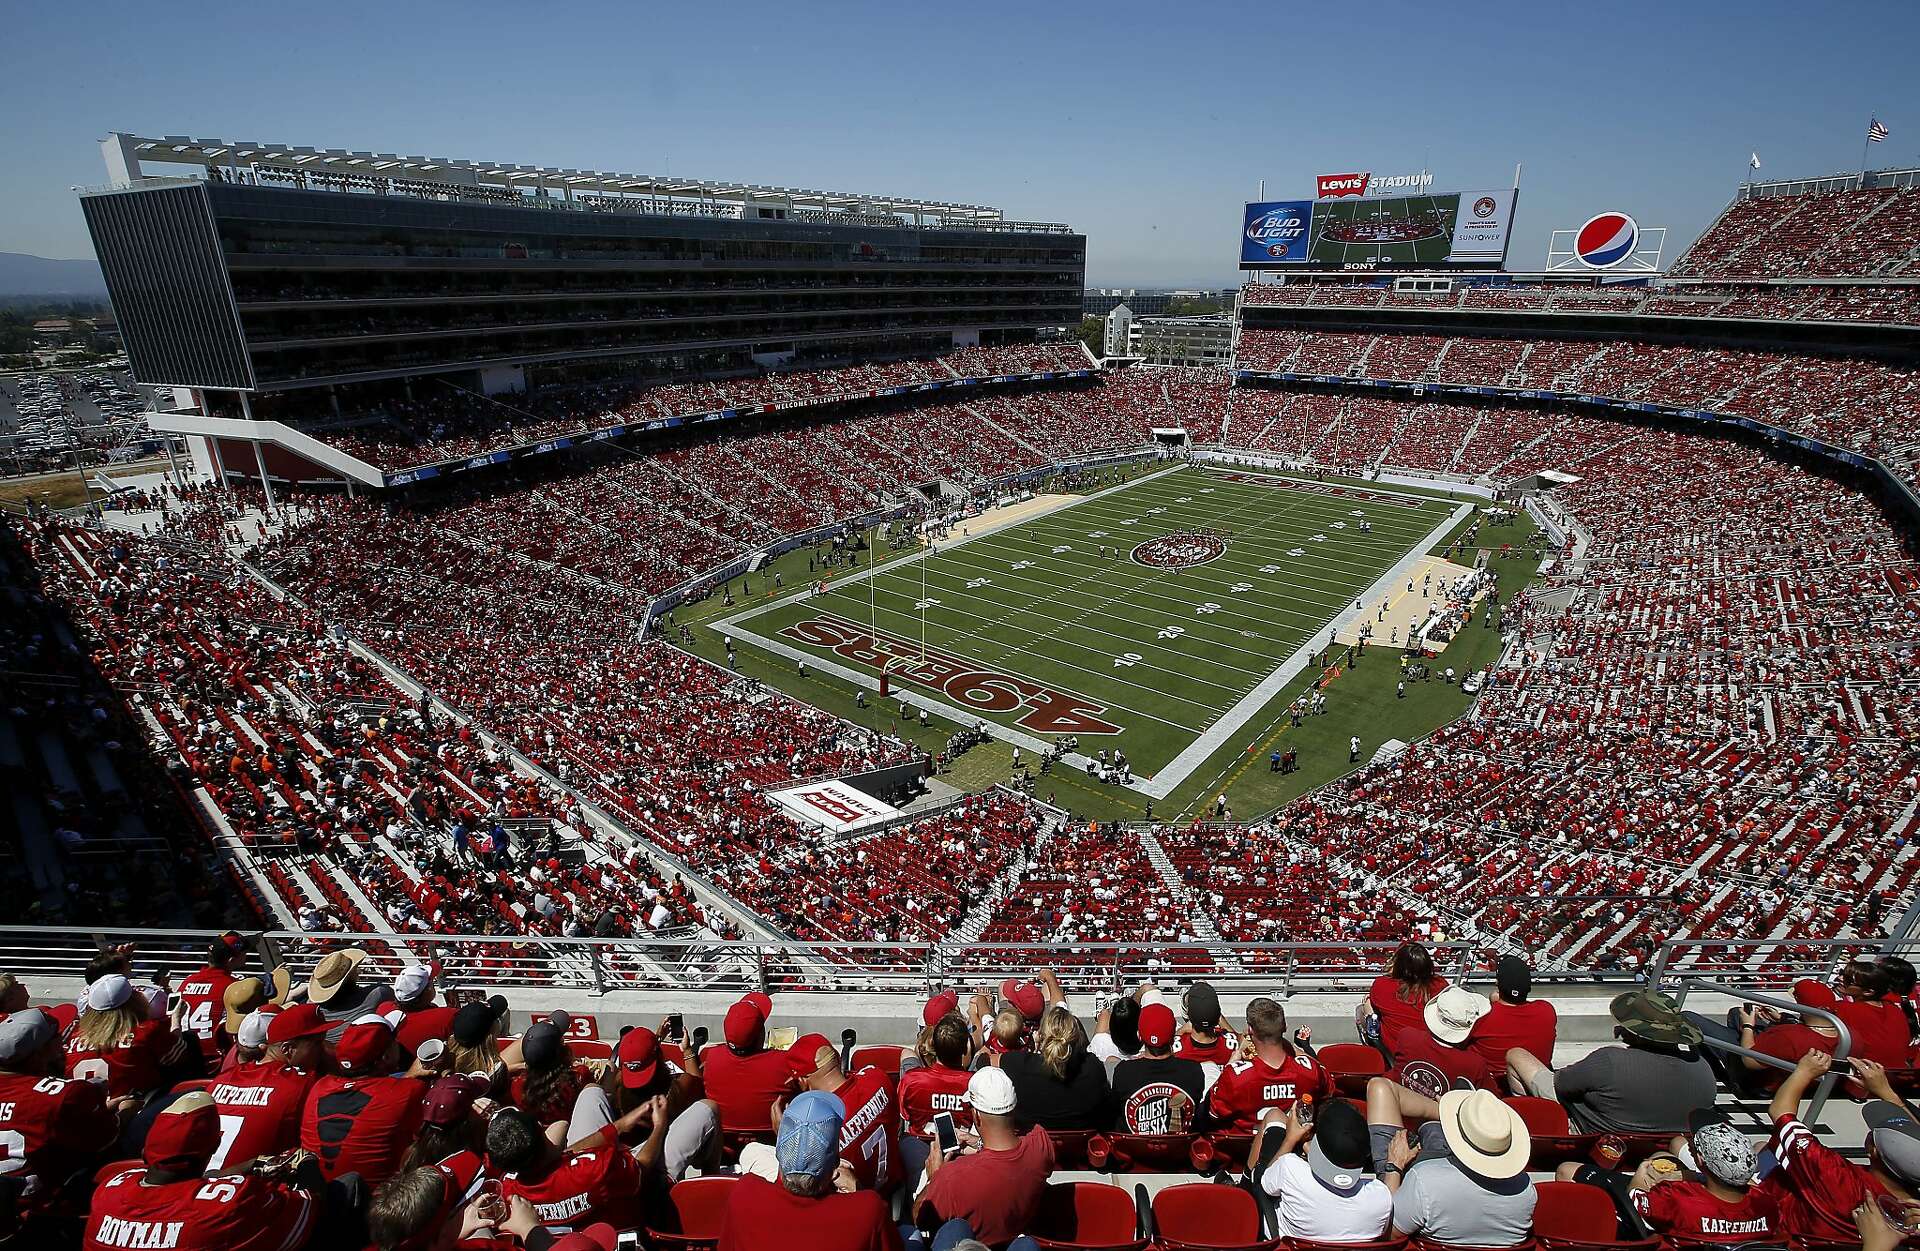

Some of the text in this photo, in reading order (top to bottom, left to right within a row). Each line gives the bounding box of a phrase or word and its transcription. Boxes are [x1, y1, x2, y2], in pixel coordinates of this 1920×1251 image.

[1370, 175, 1433, 189] STADIUM
[1263, 217, 1301, 228] BUD
[1255, 228, 1305, 238] LIGHT
[1344, 262, 1377, 270] SONY
[774, 399, 808, 411] WELCOME
[810, 398, 819, 406] TO
[844, 390, 871, 401] STADIUM
[822, 787, 882, 816] STADIUM
[182, 982, 213, 995] SMITH
[211, 1083, 275, 1106] KAEPERNICK
[1263, 1083, 1297, 1100] GORE
[931, 1093, 964, 1112] GORE
[1138, 1098, 1169, 1121] QUEST
[1138, 1121, 1150, 1132] FOR
[1150, 1114, 1169, 1136] SIX
[203, 1114, 245, 1172] 7
[861, 1123, 888, 1181] 7
[532, 1191, 592, 1221] PERNICK
[95, 1214, 185, 1249] BOWMAN
[1701, 1216, 1769, 1234] KAEPERNICK
